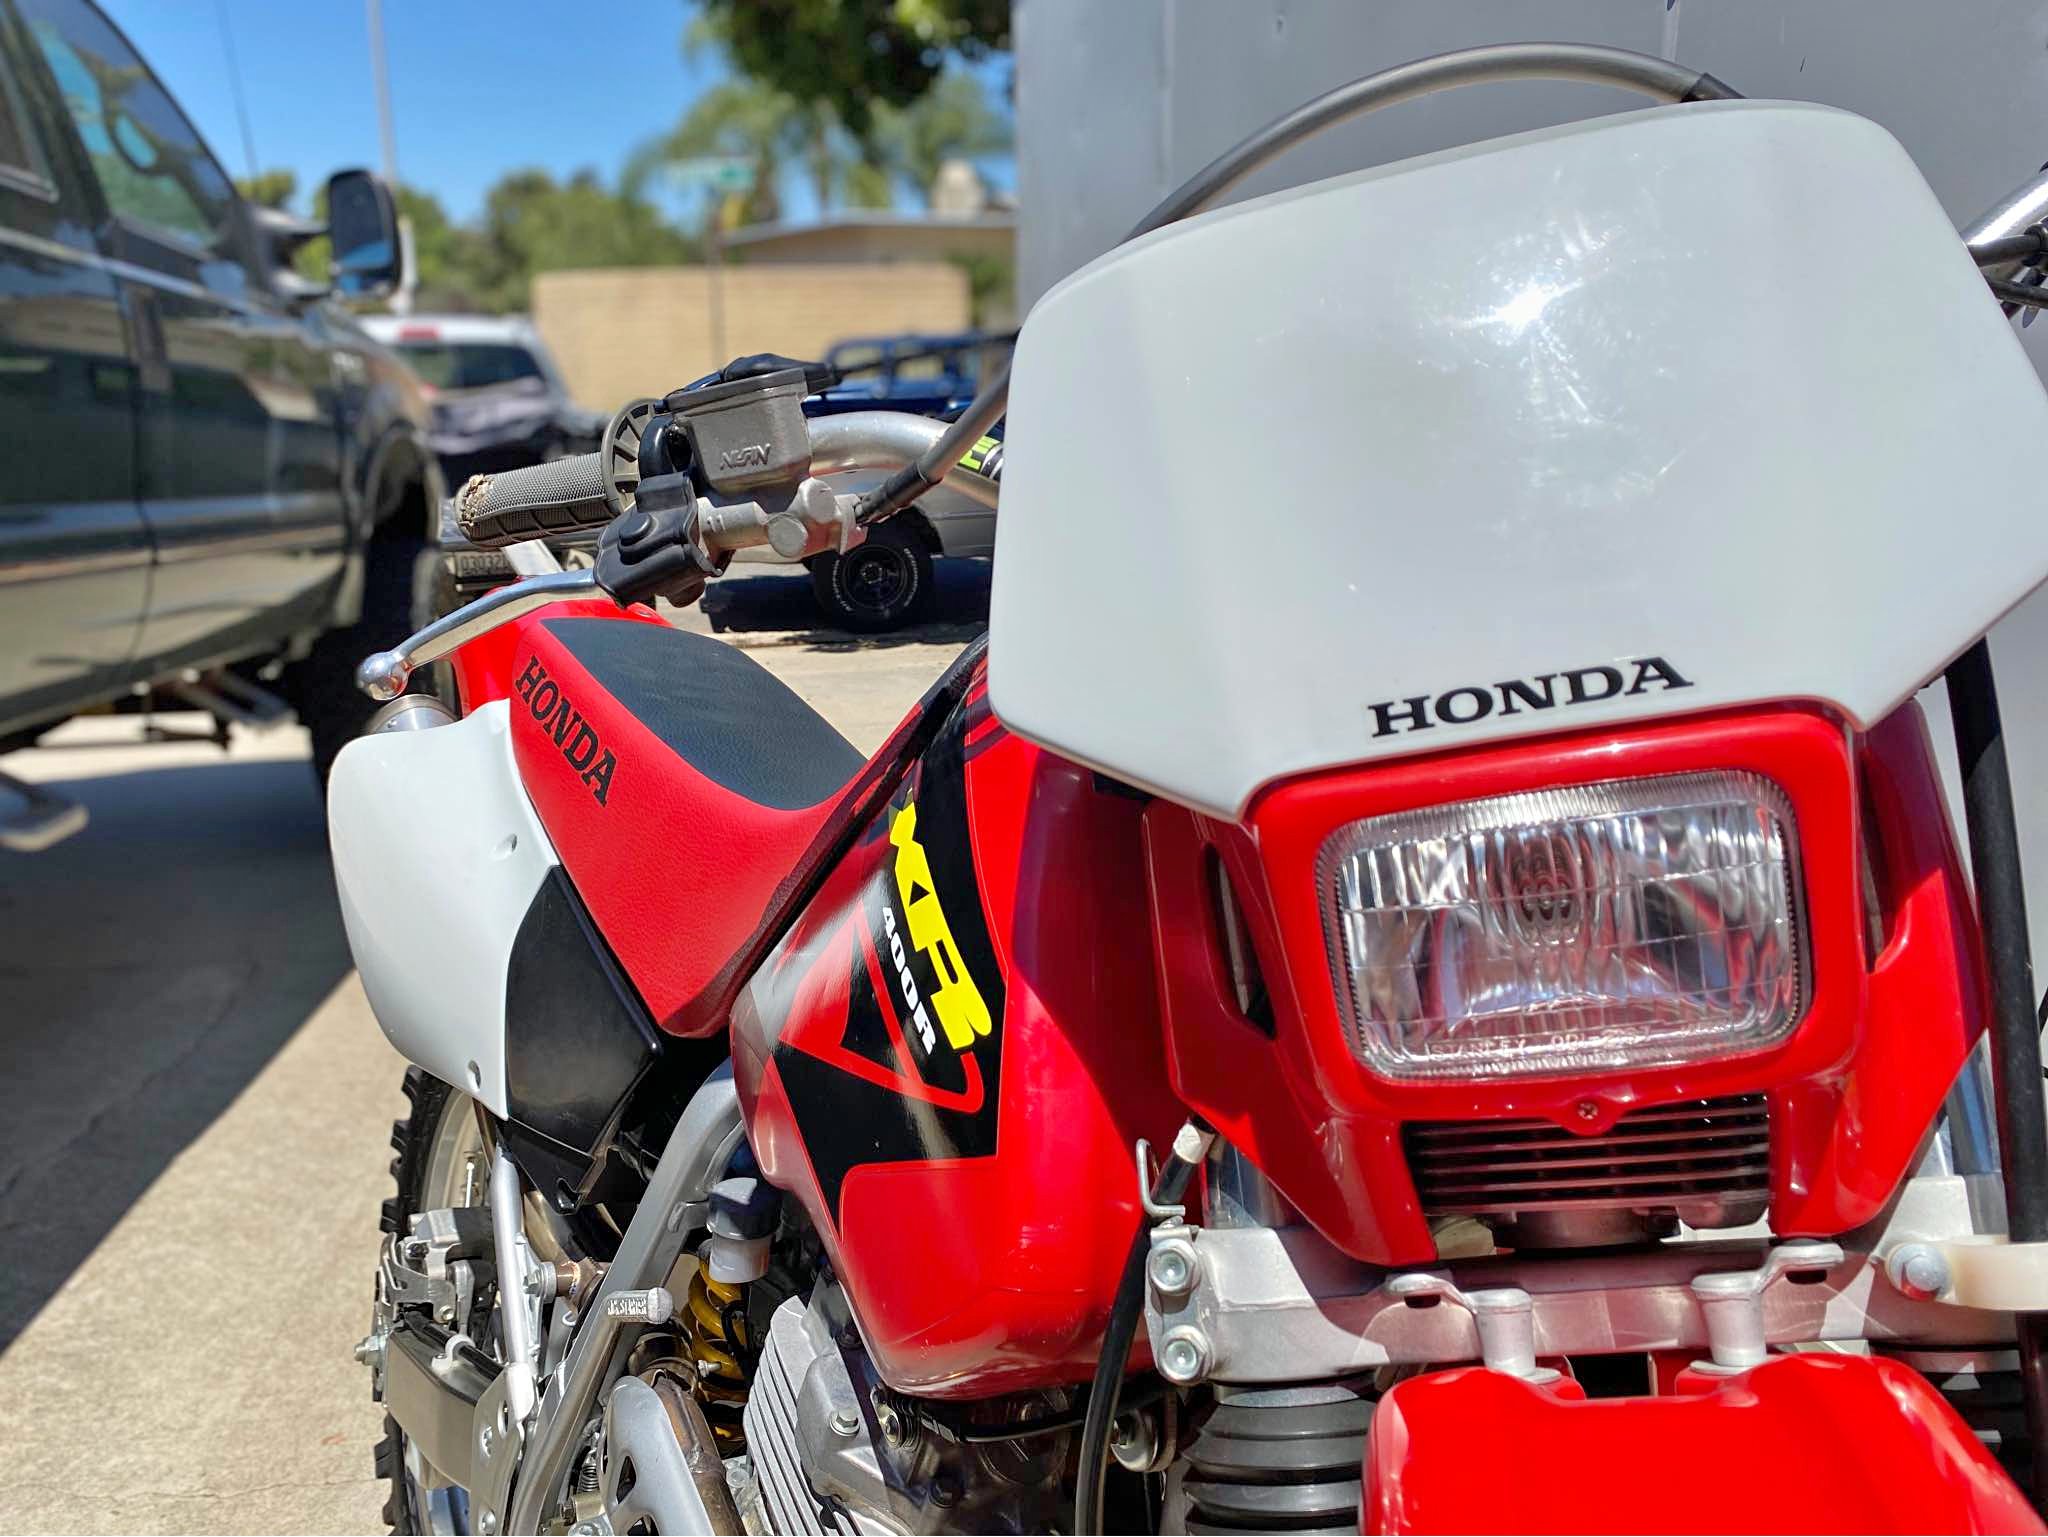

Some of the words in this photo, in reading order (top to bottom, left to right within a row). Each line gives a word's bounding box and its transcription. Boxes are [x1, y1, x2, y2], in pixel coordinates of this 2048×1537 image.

[515, 655, 616, 807] HONDA
[1368, 656, 1694, 738] HONDA
[883, 906, 936, 1055] 400R
[1430, 1037, 1526, 1061] STANLEY
